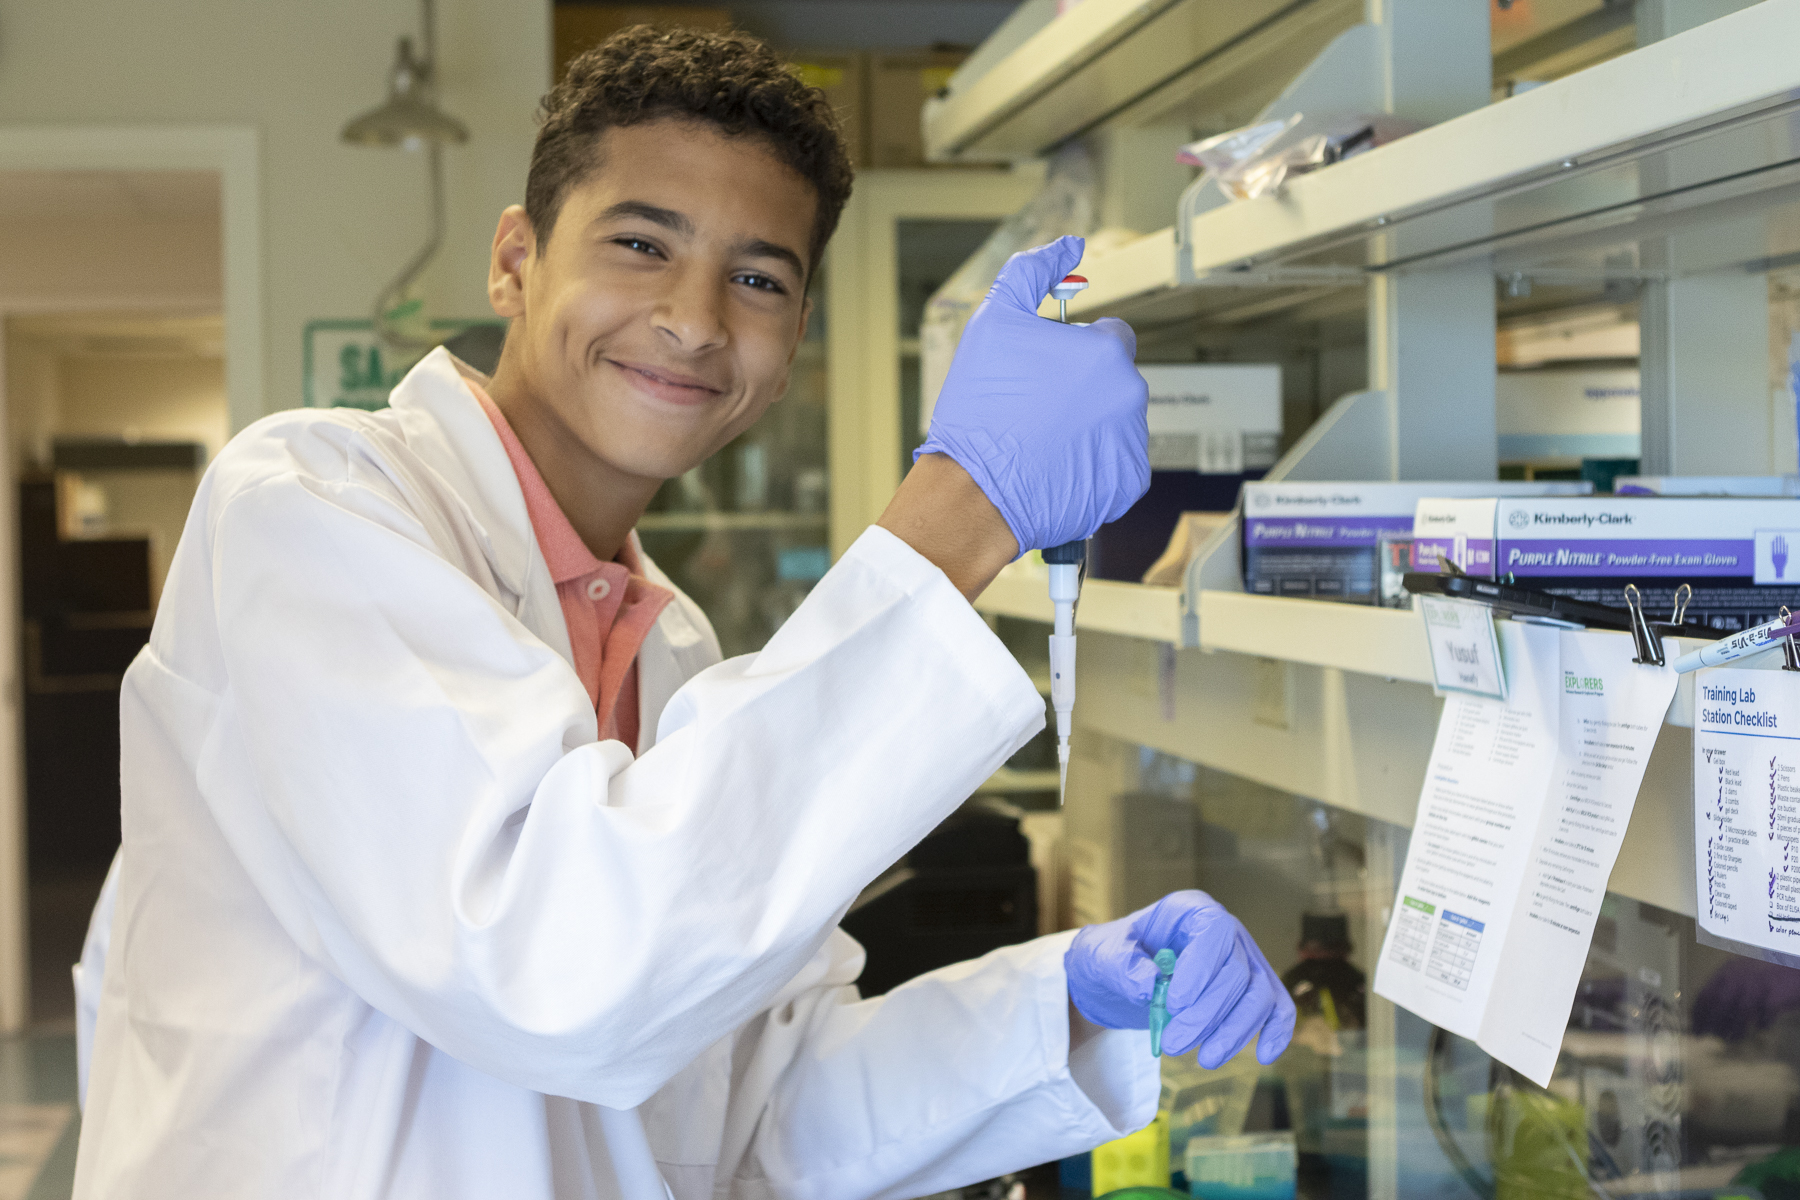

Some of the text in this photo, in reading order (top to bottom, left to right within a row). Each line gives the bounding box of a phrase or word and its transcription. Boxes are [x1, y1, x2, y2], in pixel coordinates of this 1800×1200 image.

[1533, 513, 1633, 528] Kimberly-Clark
[1508, 548, 1738, 567] PURPLE NITRILE Powder-Free Exam Gloves
[1446, 640, 1479, 665] Yusuf
[1703, 686, 1756, 705] Training Lab
[1702, 708, 1778, 728] Station Checklist
[1714, 748, 1726, 756] drawer
[1780, 764, 1796, 773] Scissors
[1780, 774, 1790, 782] Pens
[1777, 783, 1790, 792] Plastic
[1777, 794, 1789, 802] Waste
[1783, 804, 1796, 813] bucket
[1728, 826, 1747, 836] Microscope
[1747, 829, 1757, 837] slides
[1780, 824, 1792, 833] pieces
[1728, 836, 1741, 844] practice
[1741, 837, 1749, 846] slide
[1728, 854, 1742, 864] Sharpies
[1714, 861, 1739, 872] Colored pencils
[1716, 871, 1727, 880] Rulers
[1779, 873, 1792, 882] plastic
[1779, 884, 1790, 892] small
[1785, 894, 1796, 903] tubes
[1714, 899, 1727, 908] Colored
[1776, 902, 1784, 910] Box
